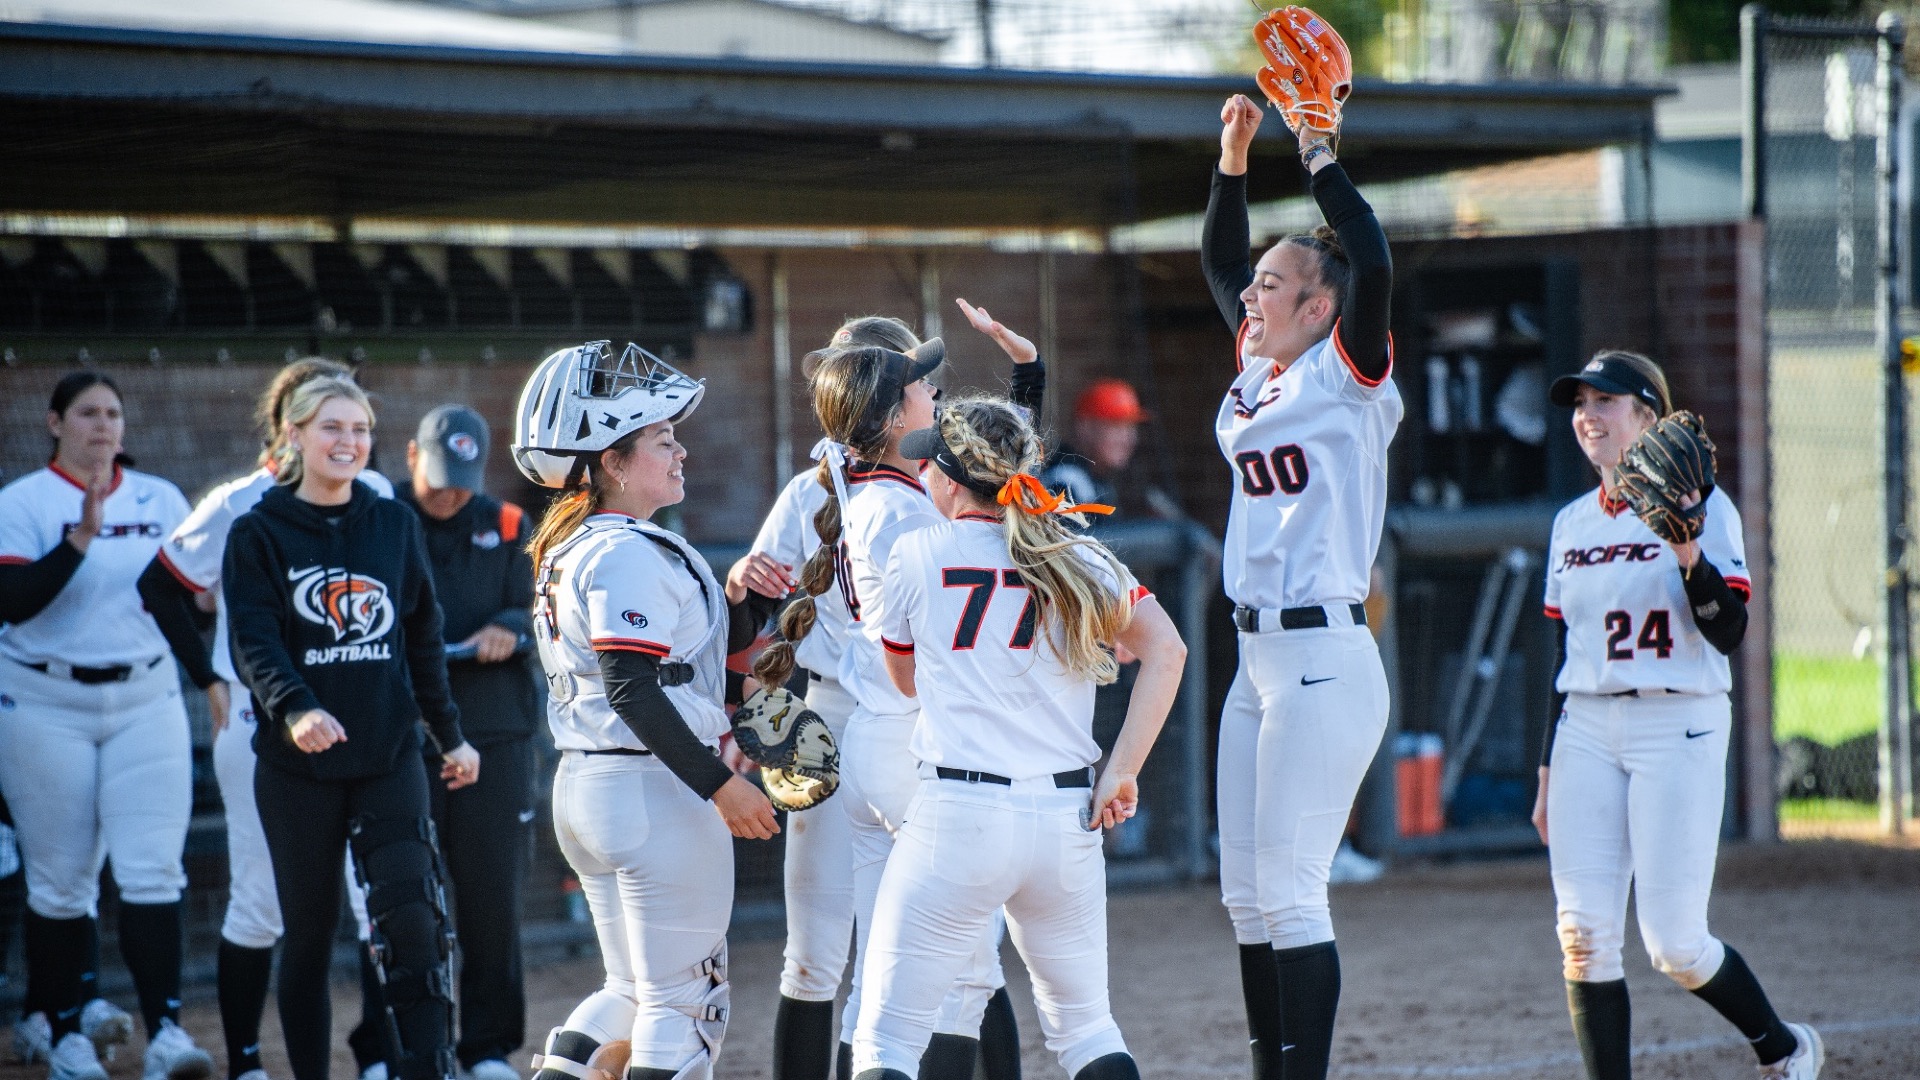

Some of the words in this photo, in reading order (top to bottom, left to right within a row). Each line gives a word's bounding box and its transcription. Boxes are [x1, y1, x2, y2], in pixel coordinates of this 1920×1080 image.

[1234, 443, 1309, 497] 00
[62, 522, 162, 539] PCIFIC
[1555, 543, 1661, 574] PACIFIC
[941, 566, 1049, 651] 77
[304, 643, 392, 665] SOFTBALL
[1604, 609, 1674, 661] 24
